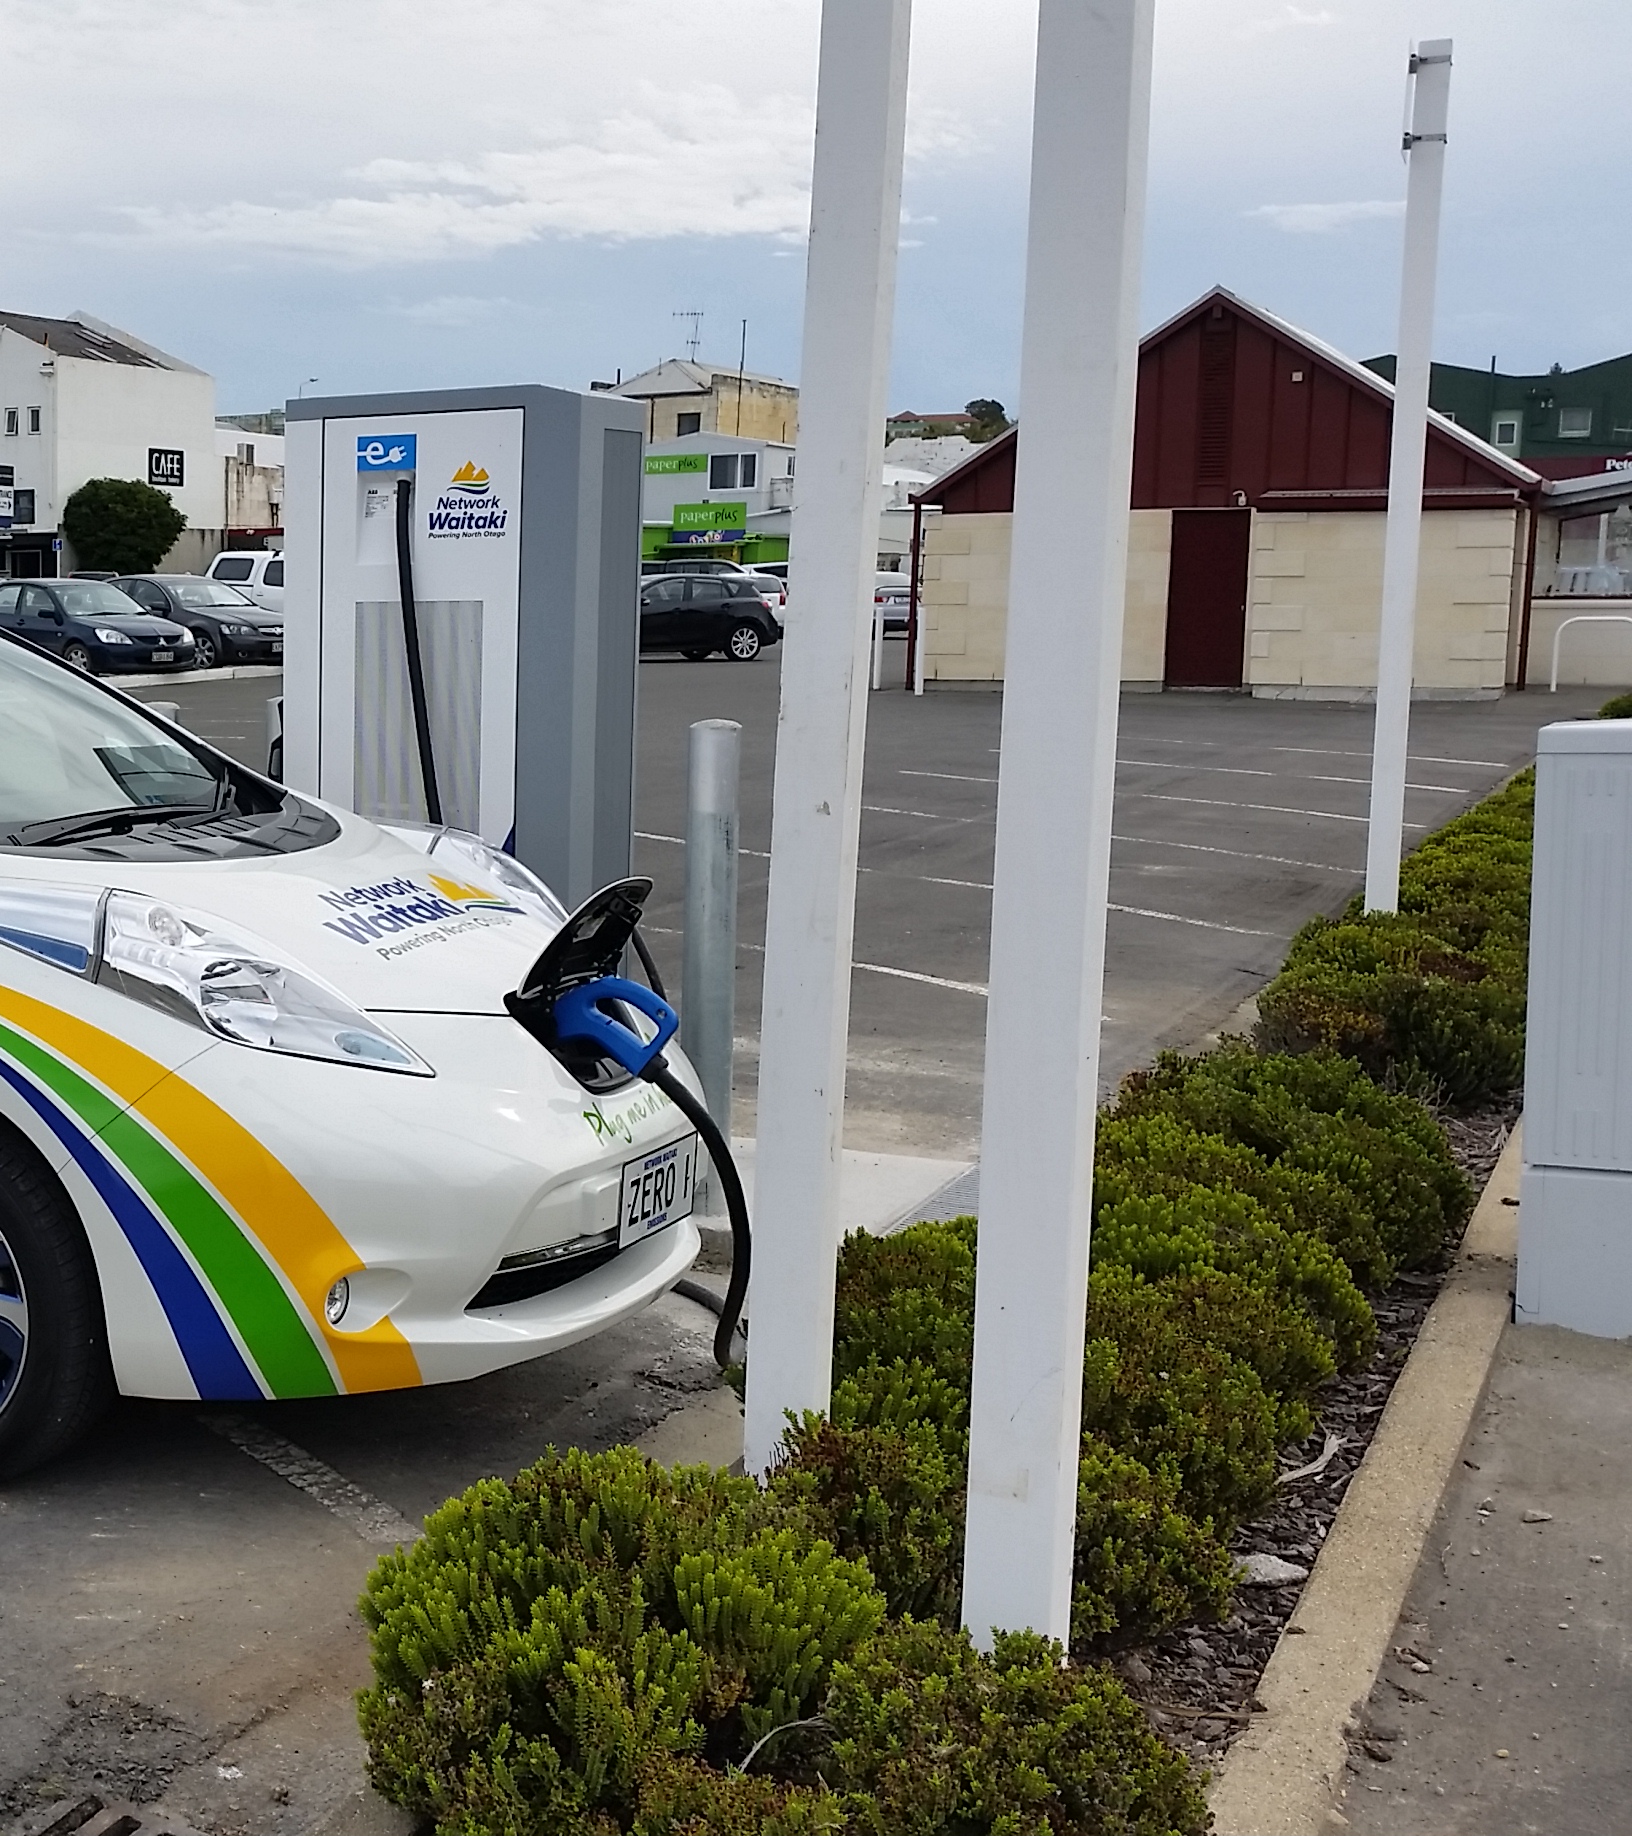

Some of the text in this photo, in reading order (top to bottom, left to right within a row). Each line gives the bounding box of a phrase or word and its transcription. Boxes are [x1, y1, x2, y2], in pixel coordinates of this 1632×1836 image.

[151, 453, 180, 476] CAFE
[646, 456, 698, 471] paperplus
[437, 495, 501, 510] Network
[429, 509, 508, 530] Waitaki
[680, 508, 738, 524] paperplus
[483, 530, 506, 538] Otago
[318, 876, 426, 912] Network
[322, 892, 466, 945] Waitaki
[376, 929, 447, 960] Powering
[582, 1101, 632, 1147] Plug
[627, 1102, 647, 1124] me
[628, 1162, 676, 1227] ZERO
